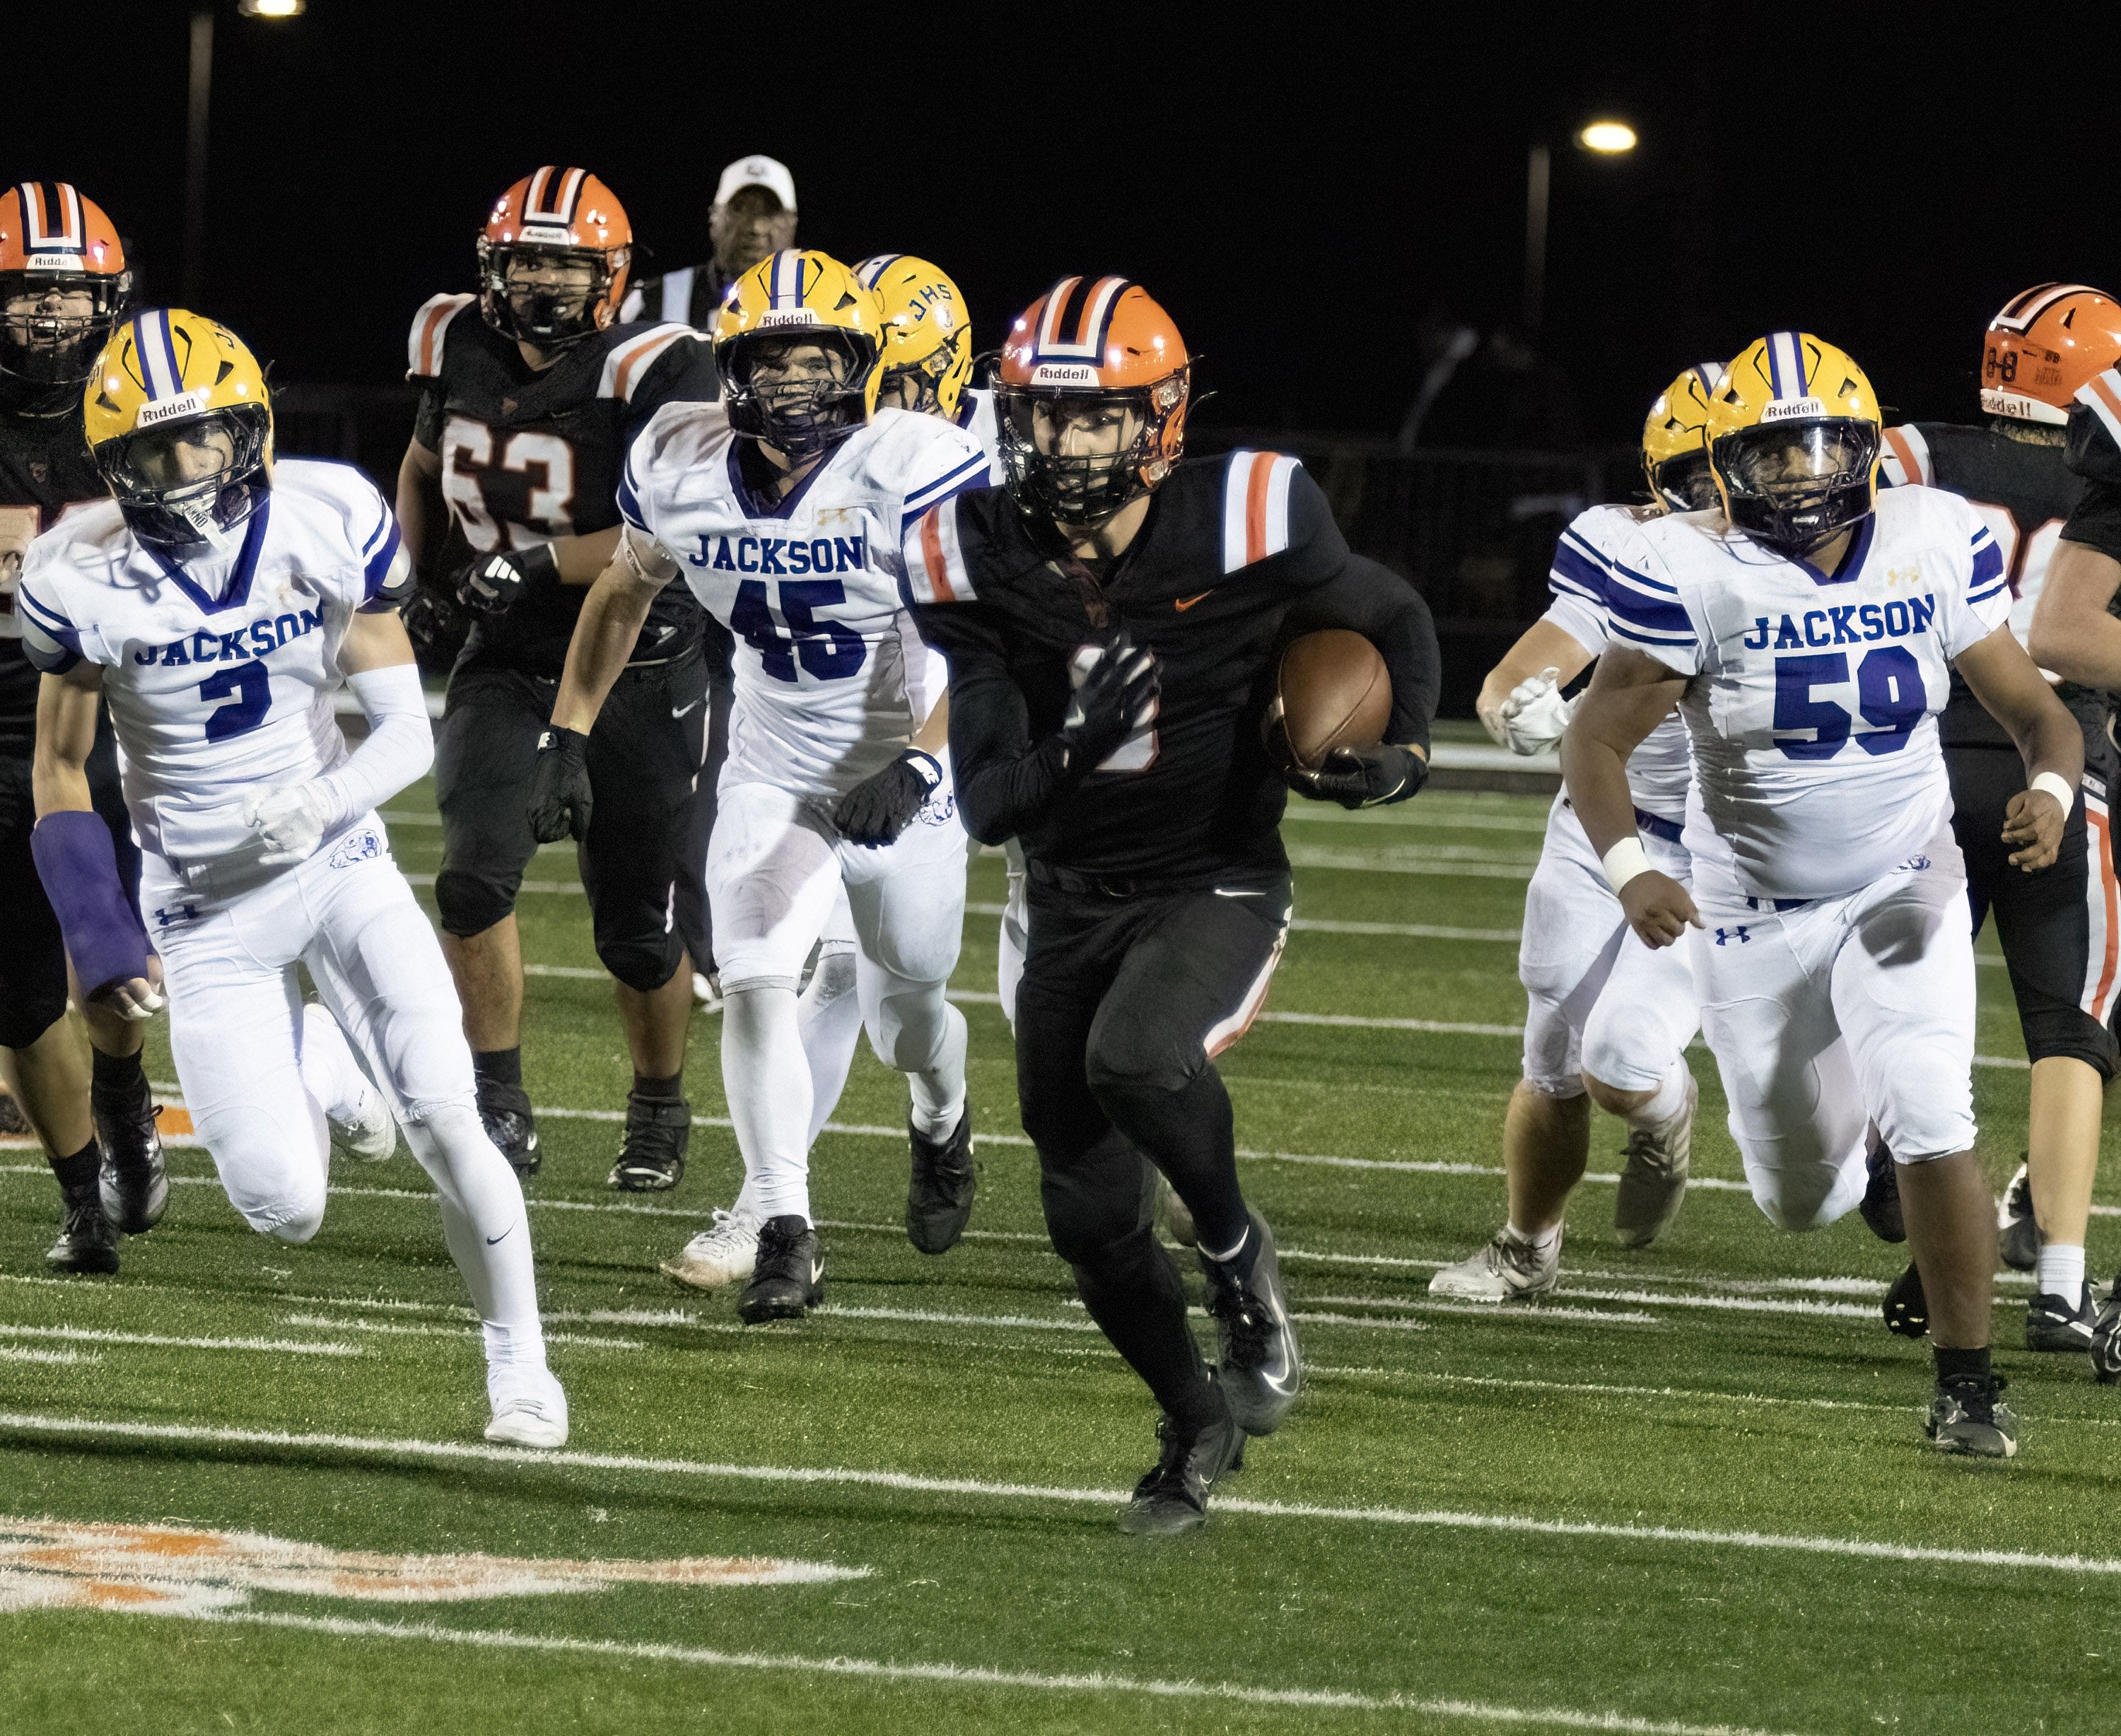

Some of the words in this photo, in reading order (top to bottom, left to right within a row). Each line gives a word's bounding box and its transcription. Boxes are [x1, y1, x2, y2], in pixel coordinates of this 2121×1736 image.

[763, 314, 812, 326] Riddell
[908, 283, 952, 322] JHS
[1039, 367, 1089, 380] Riddell
[143, 398, 197, 422] Riddell
[1767, 401, 1819, 417] Riddell
[440, 414, 574, 553] 63
[689, 533, 863, 575] JACKSON
[134, 599, 325, 667] JACKSON
[730, 579, 867, 684] 45
[1743, 593, 1936, 650] JACKSON
[1772, 645, 1927, 761] 59
